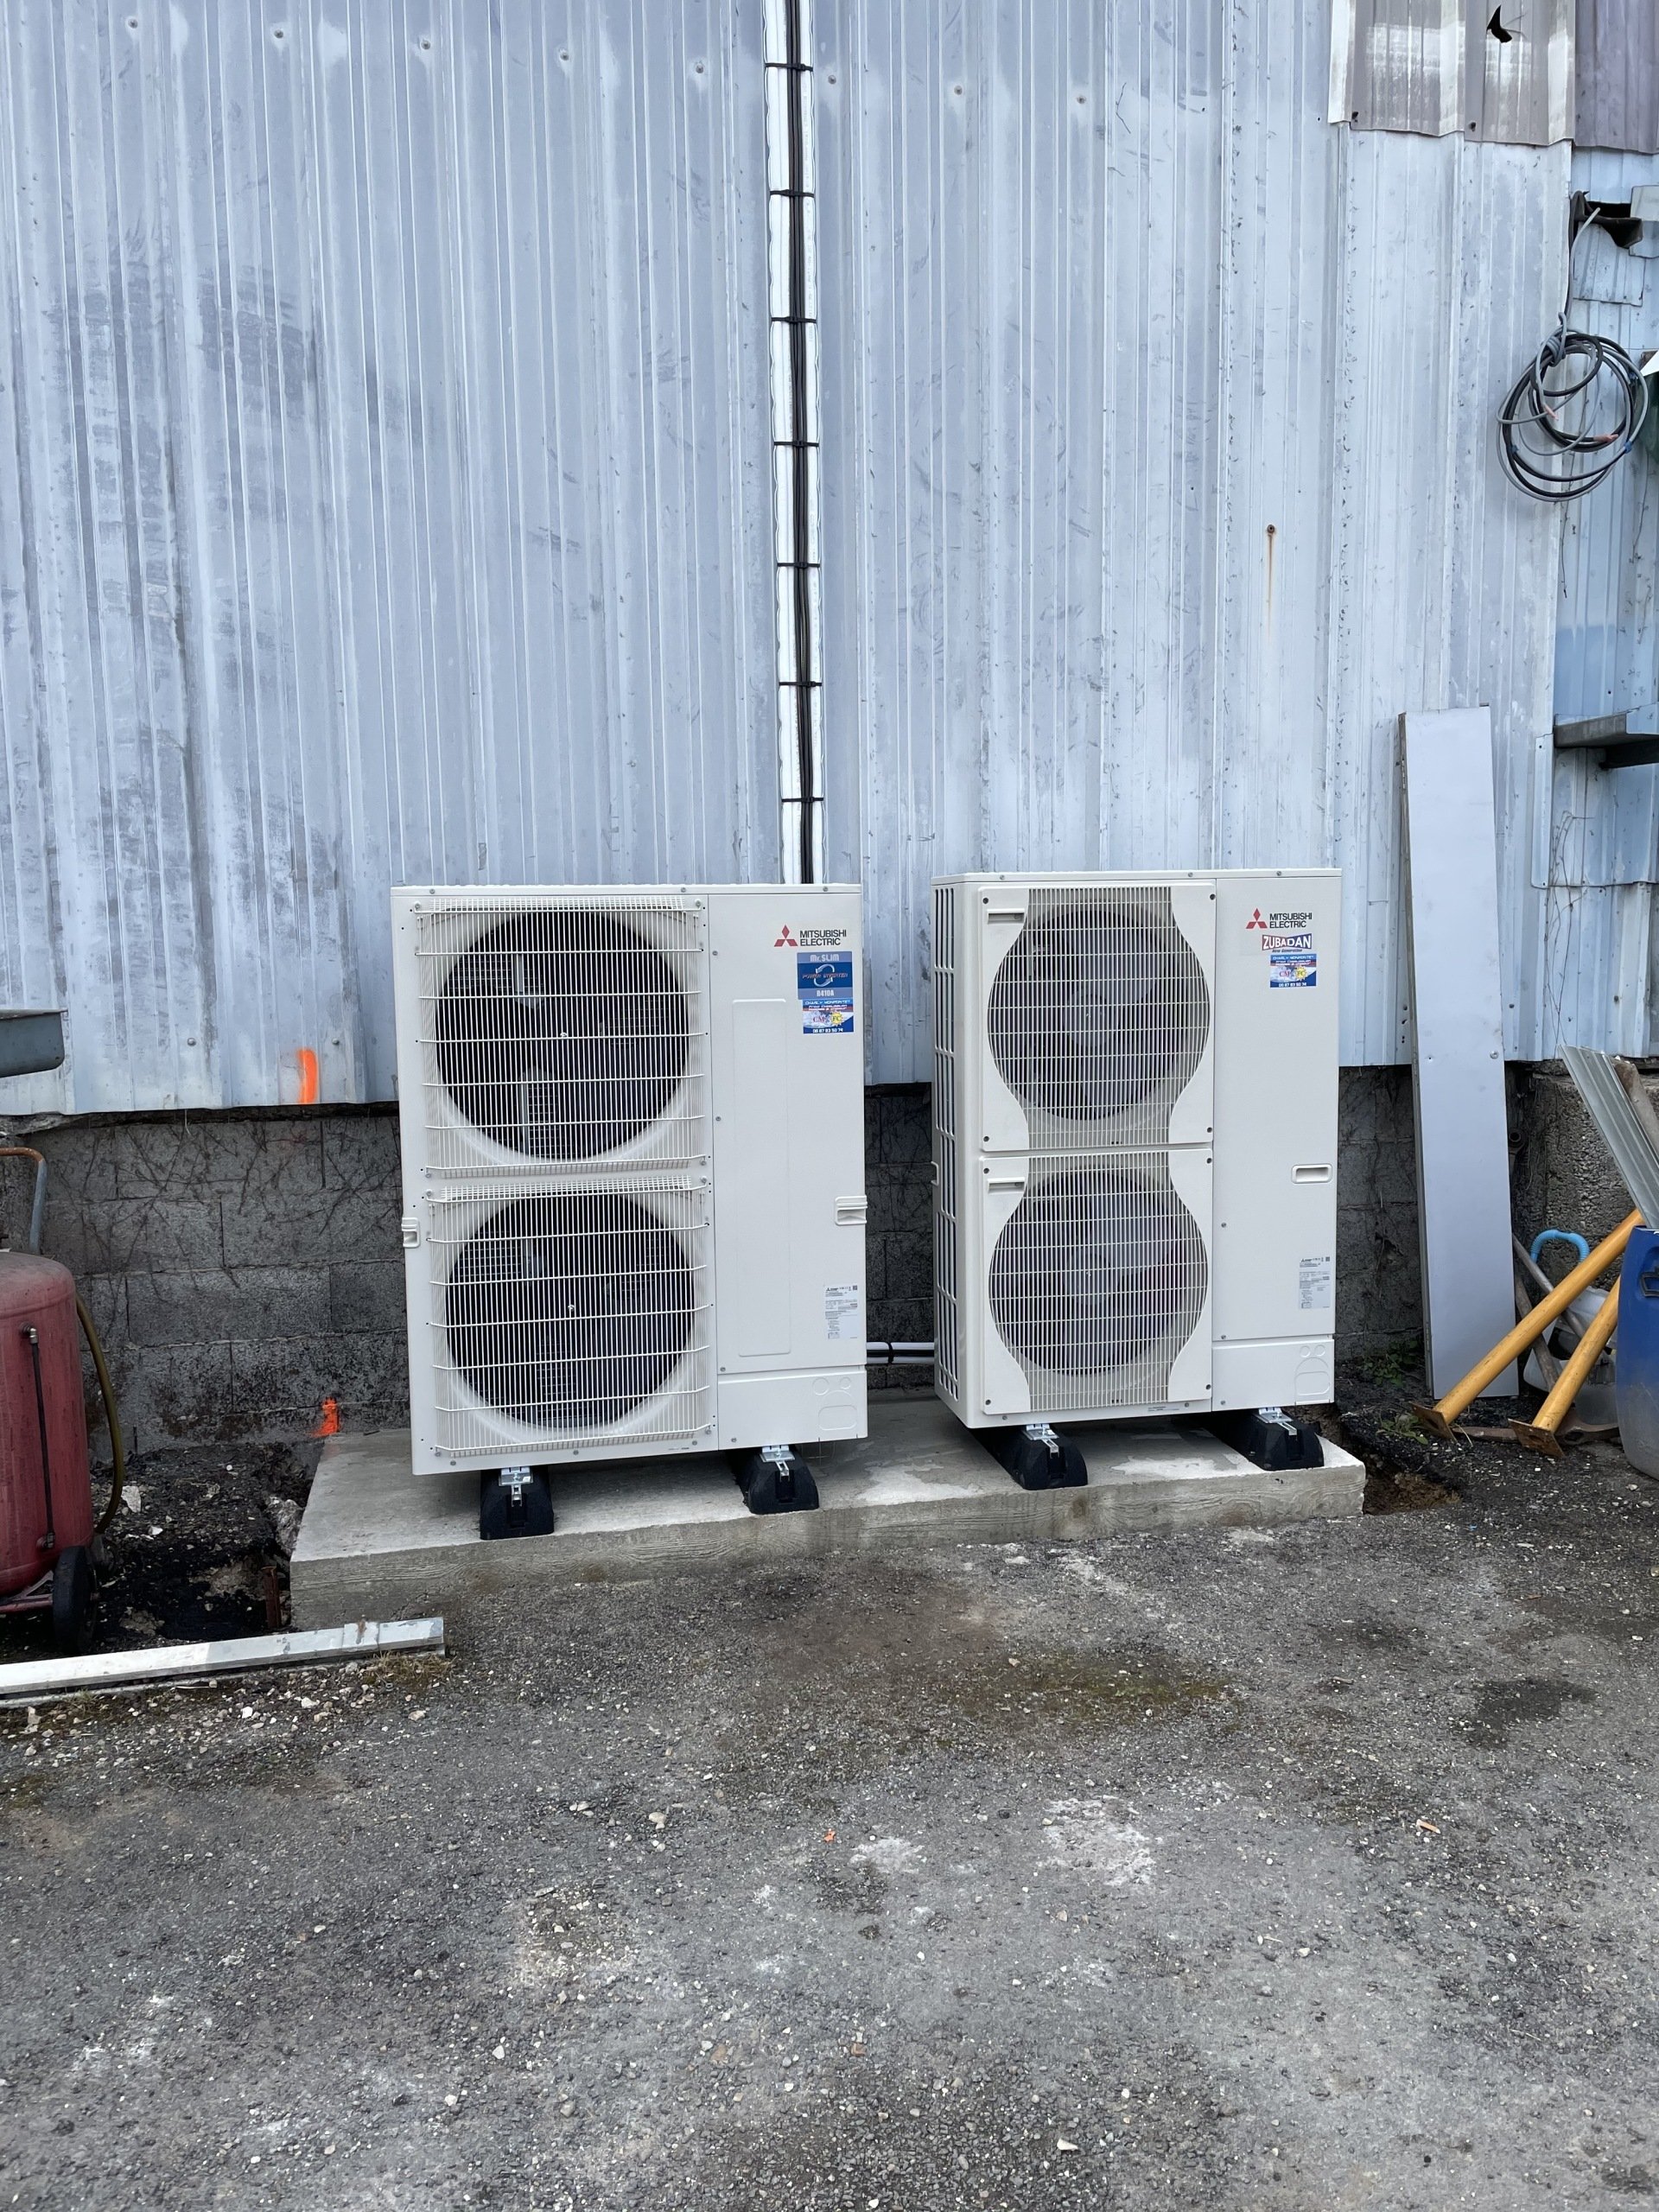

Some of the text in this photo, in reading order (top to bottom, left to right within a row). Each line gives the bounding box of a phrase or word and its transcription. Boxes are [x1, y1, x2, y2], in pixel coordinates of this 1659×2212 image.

[1269, 912, 1313, 921] MITSUBISHI
[1269, 920, 1306, 929] ELECTRIC
[799, 929, 847, 938] MITSUBISHI
[799, 938, 841, 947] ELECTRIC
[1262, 935, 1312, 950] ZUBADAN
[810, 953, 840, 963] Mr.SLIM
